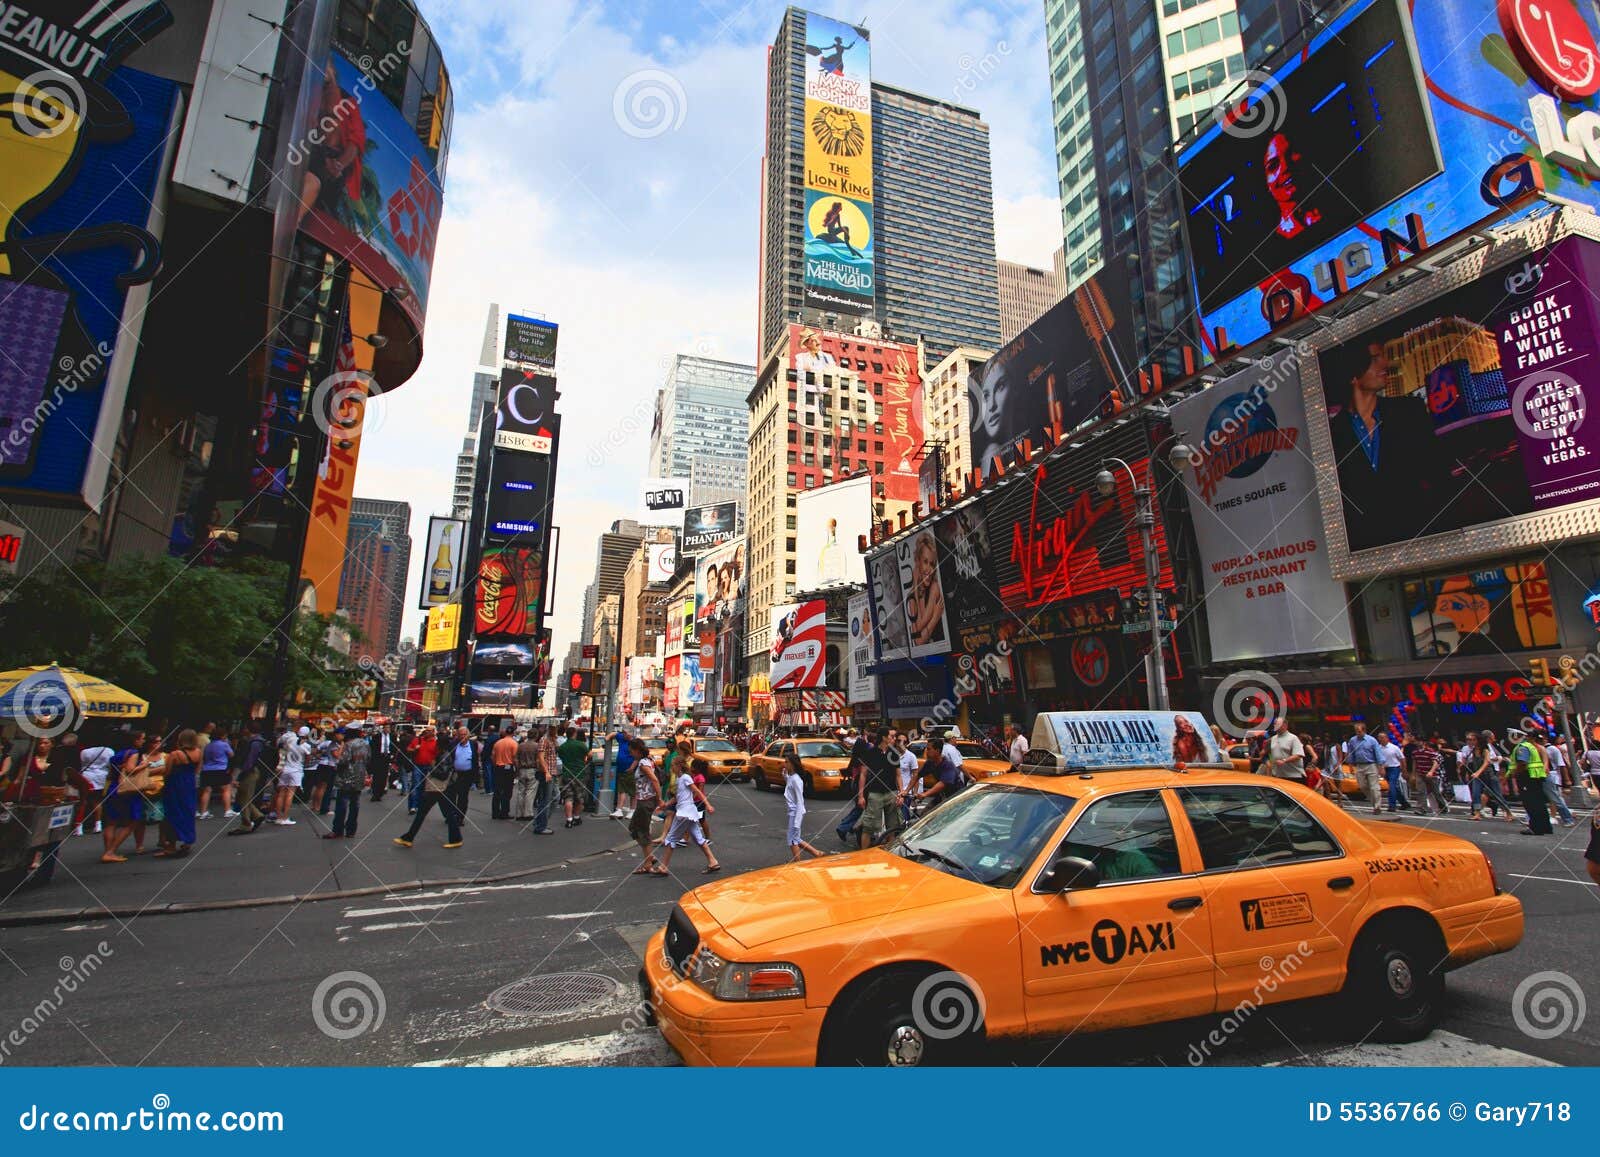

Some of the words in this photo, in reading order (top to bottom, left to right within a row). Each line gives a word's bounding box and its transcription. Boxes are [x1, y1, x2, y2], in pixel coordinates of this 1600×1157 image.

[0, 0, 107, 78] EANUT
[819, 74, 859, 95] MARY
[808, 81, 869, 109] POPPINS
[829, 162, 850, 176] THE
[806, 263, 872, 290] MERMAID
[821, 260, 835, 270] THE
[837, 264, 860, 274] LITTLE
[1510, 294, 1558, 325] BOOK
[512, 321, 552, 334] retirement
[1503, 329, 1513, 343] A
[1518, 304, 1573, 336] NIGHT
[518, 329, 546, 340] income
[519, 335, 530, 343] for
[531, 337, 544, 346] life
[1515, 326, 1563, 353] WITH
[1517, 341, 1574, 369] FAME.
[1536, 379, 1562, 394] THE
[507, 384, 544, 425] C
[1525, 384, 1583, 410] HOTTEST
[1539, 401, 1571, 418] NEW
[1532, 408, 1585, 432] RESORT
[497, 434, 531, 447] HSBC
[888, 406, 915, 458] Juan
[1552, 425, 1568, 439] IN
[1550, 437, 1576, 451] LAS
[1543, 445, 1591, 466] VEGAS.
[505, 482, 533, 490] SAMSUNG
[645, 489, 684, 509] RENT
[1214, 495, 1243, 512] TIMES
[1244, 482, 1287, 503] SQUARE
[496, 521, 535, 532] SAMSUNG
[1010, 463, 1116, 607] Virgin
[684, 530, 736, 546] PHANTOM
[662, 557, 675, 565] TN
[1211, 540, 1317, 573] WORLD-FAMOUS
[1222, 559, 1308, 588] RESTAURANT
[1245, 587, 1256, 600] &
[1258, 582, 1286, 597] BAR
[904, 681, 924, 692] RETAIL
[1350, 675, 1560, 708] HOLLYWOO
[80, 700, 143, 714] SABRETT
[897, 693, 936, 705] OPPORTUNITY
[1064, 720, 1124, 745] MAMMA
[1123, 718, 1160, 744] MIA!
[1071, 744, 1103, 754] THE
[1112, 742, 1162, 753] MOVIE
[1040, 940, 1091, 967] NYC
[1092, 920, 1176, 964] TAXI
